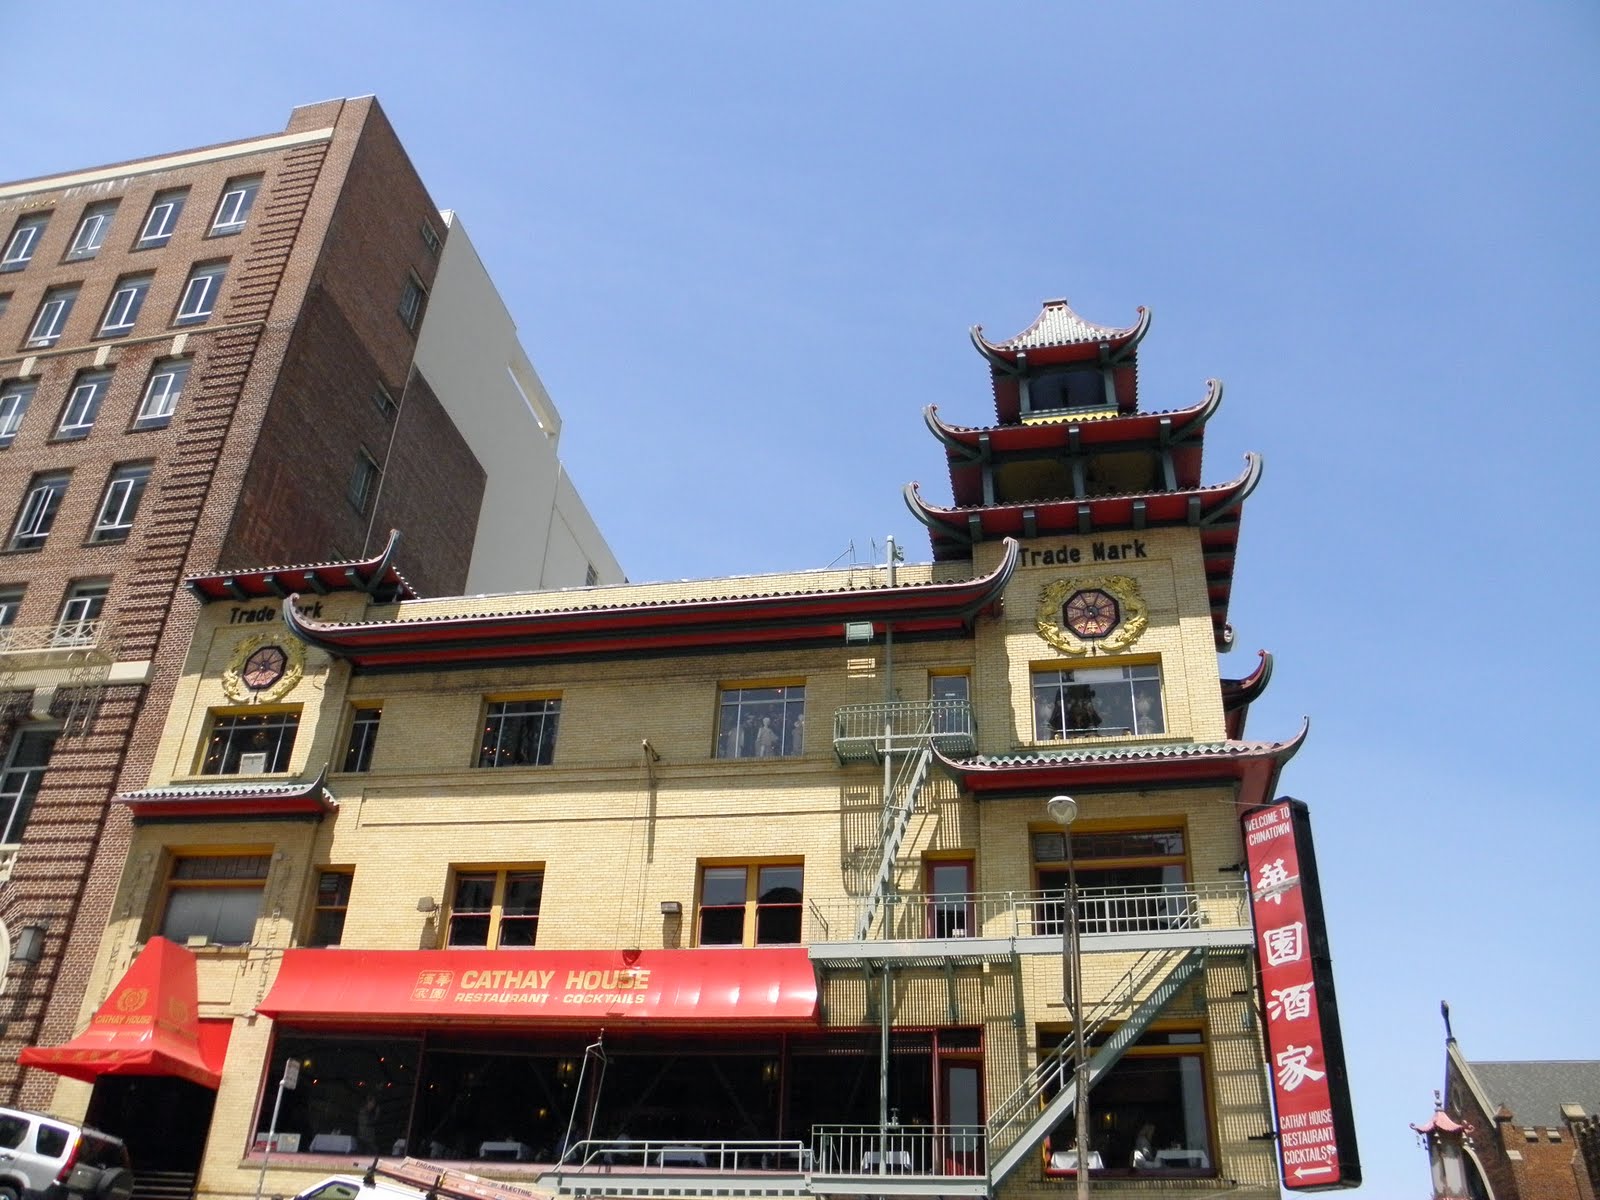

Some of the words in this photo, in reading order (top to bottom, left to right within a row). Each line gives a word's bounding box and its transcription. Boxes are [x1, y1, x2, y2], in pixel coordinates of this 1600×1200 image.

[1018, 544, 1081, 567] Trade
[1092, 539, 1147, 562] Mark
[230, 606, 276, 624] Trade
[1244, 811, 1278, 832] WELCOME
[1280, 806, 1290, 820] TO
[1249, 822, 1290, 846] CHINATOWN
[460, 970, 555, 990] CATHAY
[565, 970, 651, 990] HOUSE
[454, 992, 550, 1004] RESTAURANT
[563, 992, 645, 1004] COCKTAILS
[95, 1015, 125, 1025] CATHAY
[125, 1015, 152, 1025] HOUSE
[1280, 1112, 1308, 1130] CATHAY
[1308, 1108, 1333, 1125] HOUSE
[1282, 1126, 1334, 1147] RESTAURANT
[1284, 1146, 1328, 1165] COCKTAILS
